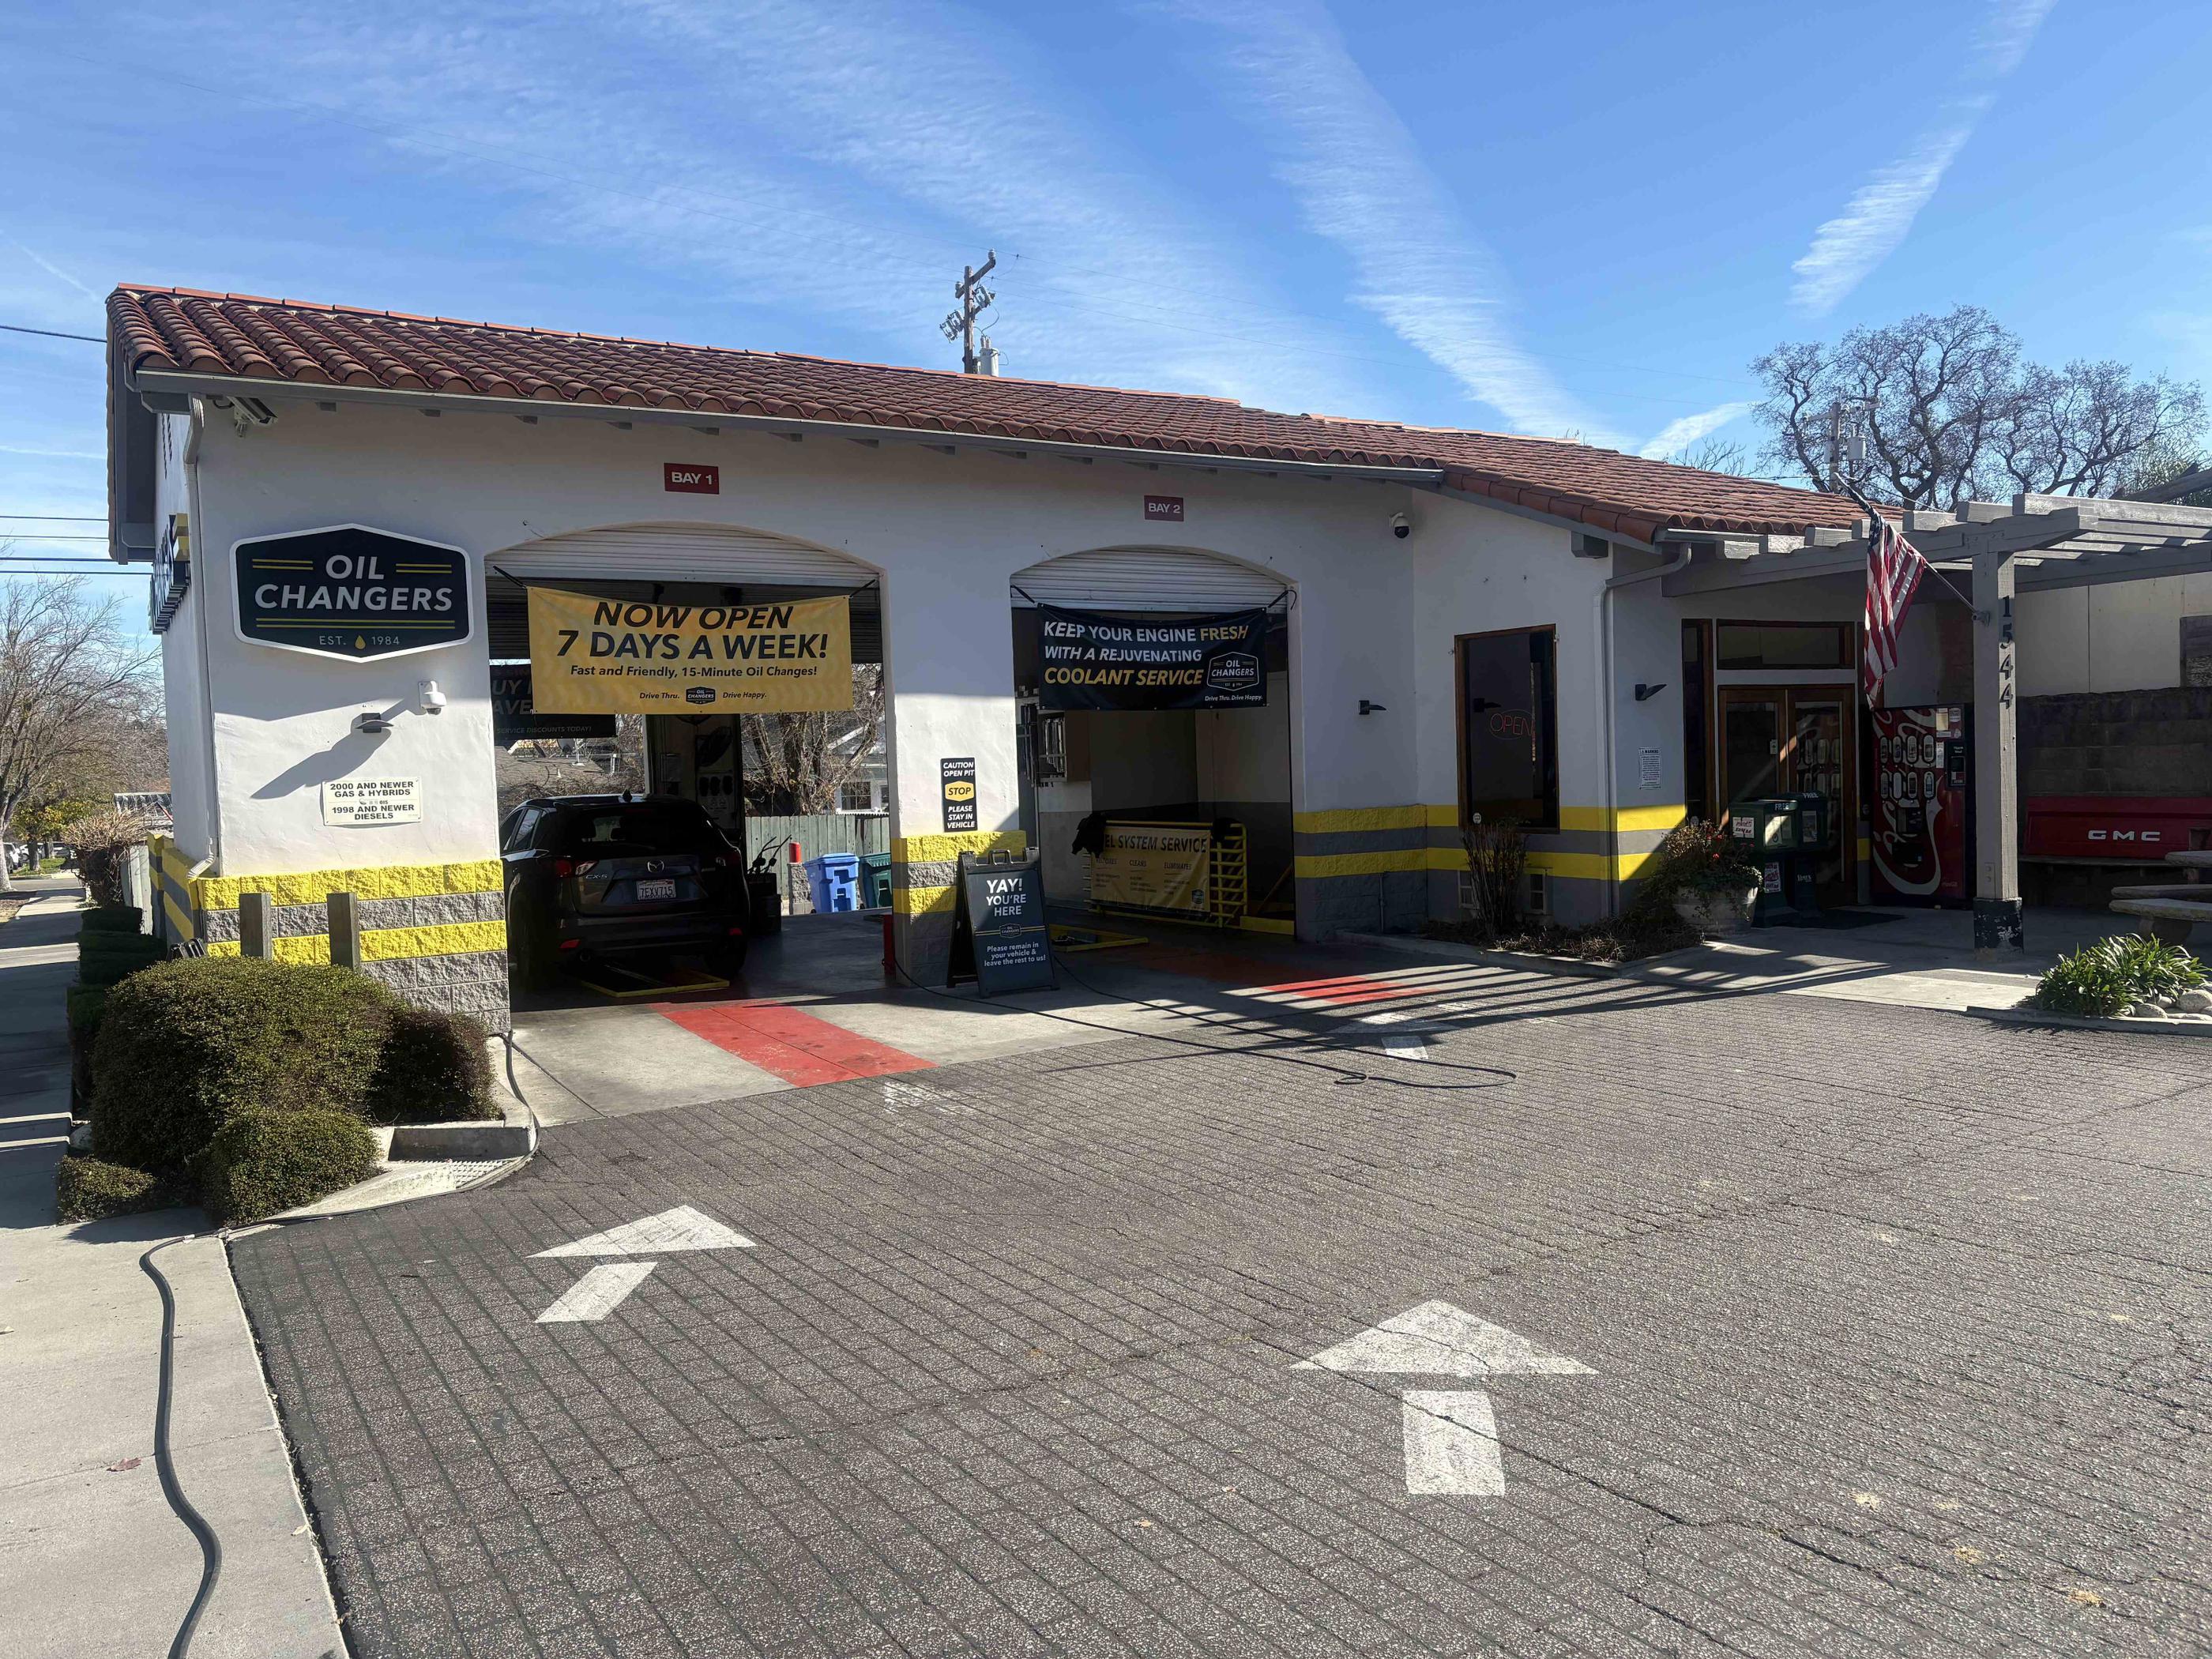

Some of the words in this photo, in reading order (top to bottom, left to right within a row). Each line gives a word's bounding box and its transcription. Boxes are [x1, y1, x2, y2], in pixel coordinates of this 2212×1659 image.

[672, 471, 702, 484] BAY
[705, 475, 713, 485] 1
[1148, 502, 1170, 514] BAY
[1173, 504, 1181, 514] 2
[325, 555, 385, 581] OIL
[254, 584, 453, 611] CHANGERS
[593, 601, 692, 630] NOW
[698, 605, 794, 630] OPEN
[1044, 621, 1085, 638] KEEP
[1088, 626, 1133, 642] YOUR
[1136, 628, 1197, 642] ENGINE
[1200, 625, 1249, 641] FRESH
[318, 635, 347, 646] EST.
[371, 635, 401, 646] 1984
[556, 630, 579, 657] 7
[589, 632, 680, 660] DAYS
[687, 634, 714, 660] A
[722, 634, 828, 660] WEEK!
[1044, 645, 1082, 660] WITH
[1083, 648, 1096, 661] A
[1099, 648, 1202, 663] REJUVENATING
[1225, 660, 1240, 668] OIL
[570, 664, 595, 676] Fast
[599, 664, 623, 676] and
[626, 665, 678, 679] Friendly,
[683, 665, 743, 678] 15-Minute
[746, 665, 764, 677] Oil
[766, 665, 818, 679] Changes!
[1044, 668, 1135, 686] COOLANT
[1135, 668, 1205, 687] SERVICE
[1211, 668, 1255, 677] CHANGERS
[1491, 713, 1535, 737] OPEN
[330, 782, 354, 791] 2000
[356, 781, 377, 790] AND
[948, 787, 972, 796] STOP
[368, 788, 411, 797] HYBRIDS
[332, 806, 355, 814] 1998
[354, 812, 393, 821] DIESELS
[2088, 830, 2161, 841] GMC
[1118, 834, 1157, 851] SYSTEM
[1161, 837, 1208, 853] SERVICE
[986, 878, 1023, 894] YAY!
[986, 893, 1027, 906] YOU'RE
[994, 905, 1022, 917] HERE
[991, 952, 1006, 961] your
[1007, 950, 1030, 958] vehicle
[1003, 957, 1014, 965] the
[1014, 955, 1027, 964] rest
